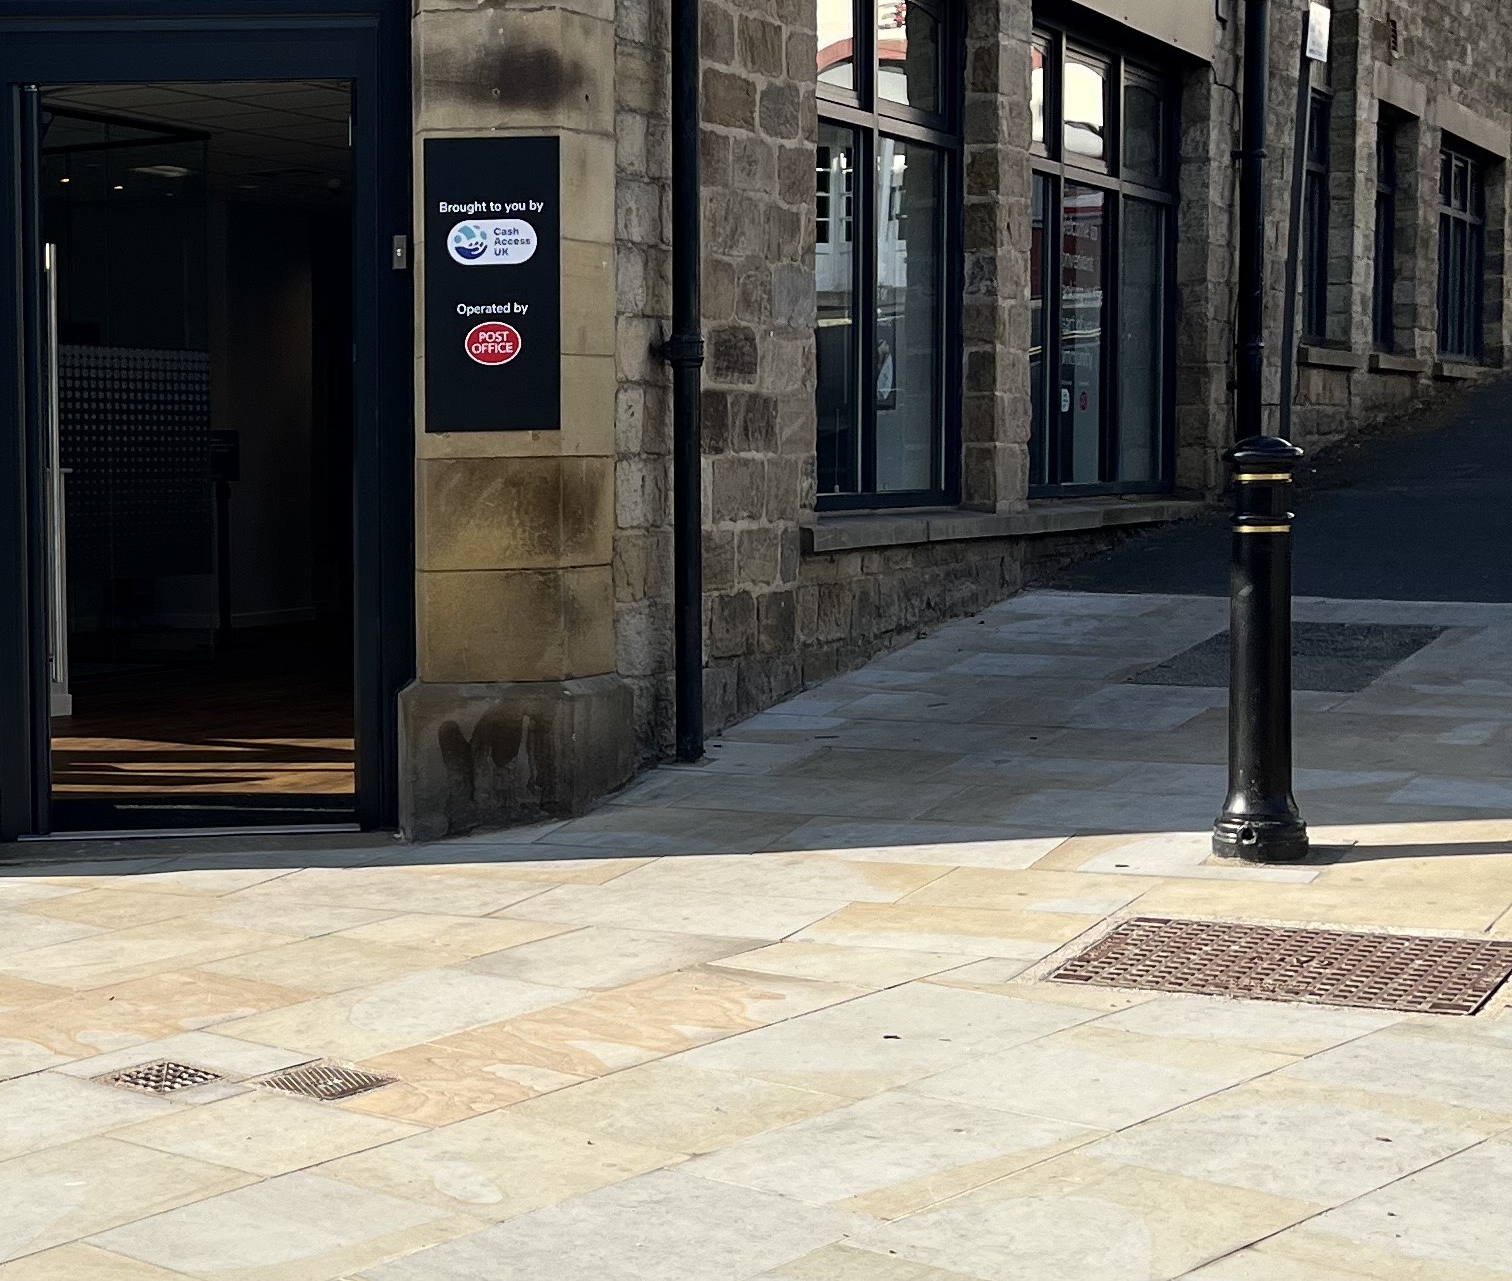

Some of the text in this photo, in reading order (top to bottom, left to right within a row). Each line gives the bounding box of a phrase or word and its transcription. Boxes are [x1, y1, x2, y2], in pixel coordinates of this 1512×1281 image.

[439, 199, 544, 215] Brought to you by
[493, 226, 520, 236] Cash
[494, 237, 531, 246] Access
[494, 248, 510, 257] UK
[456, 301, 529, 317] Operated by
[478, 331, 509, 343] POST
[471, 341, 514, 355] OFFICE
